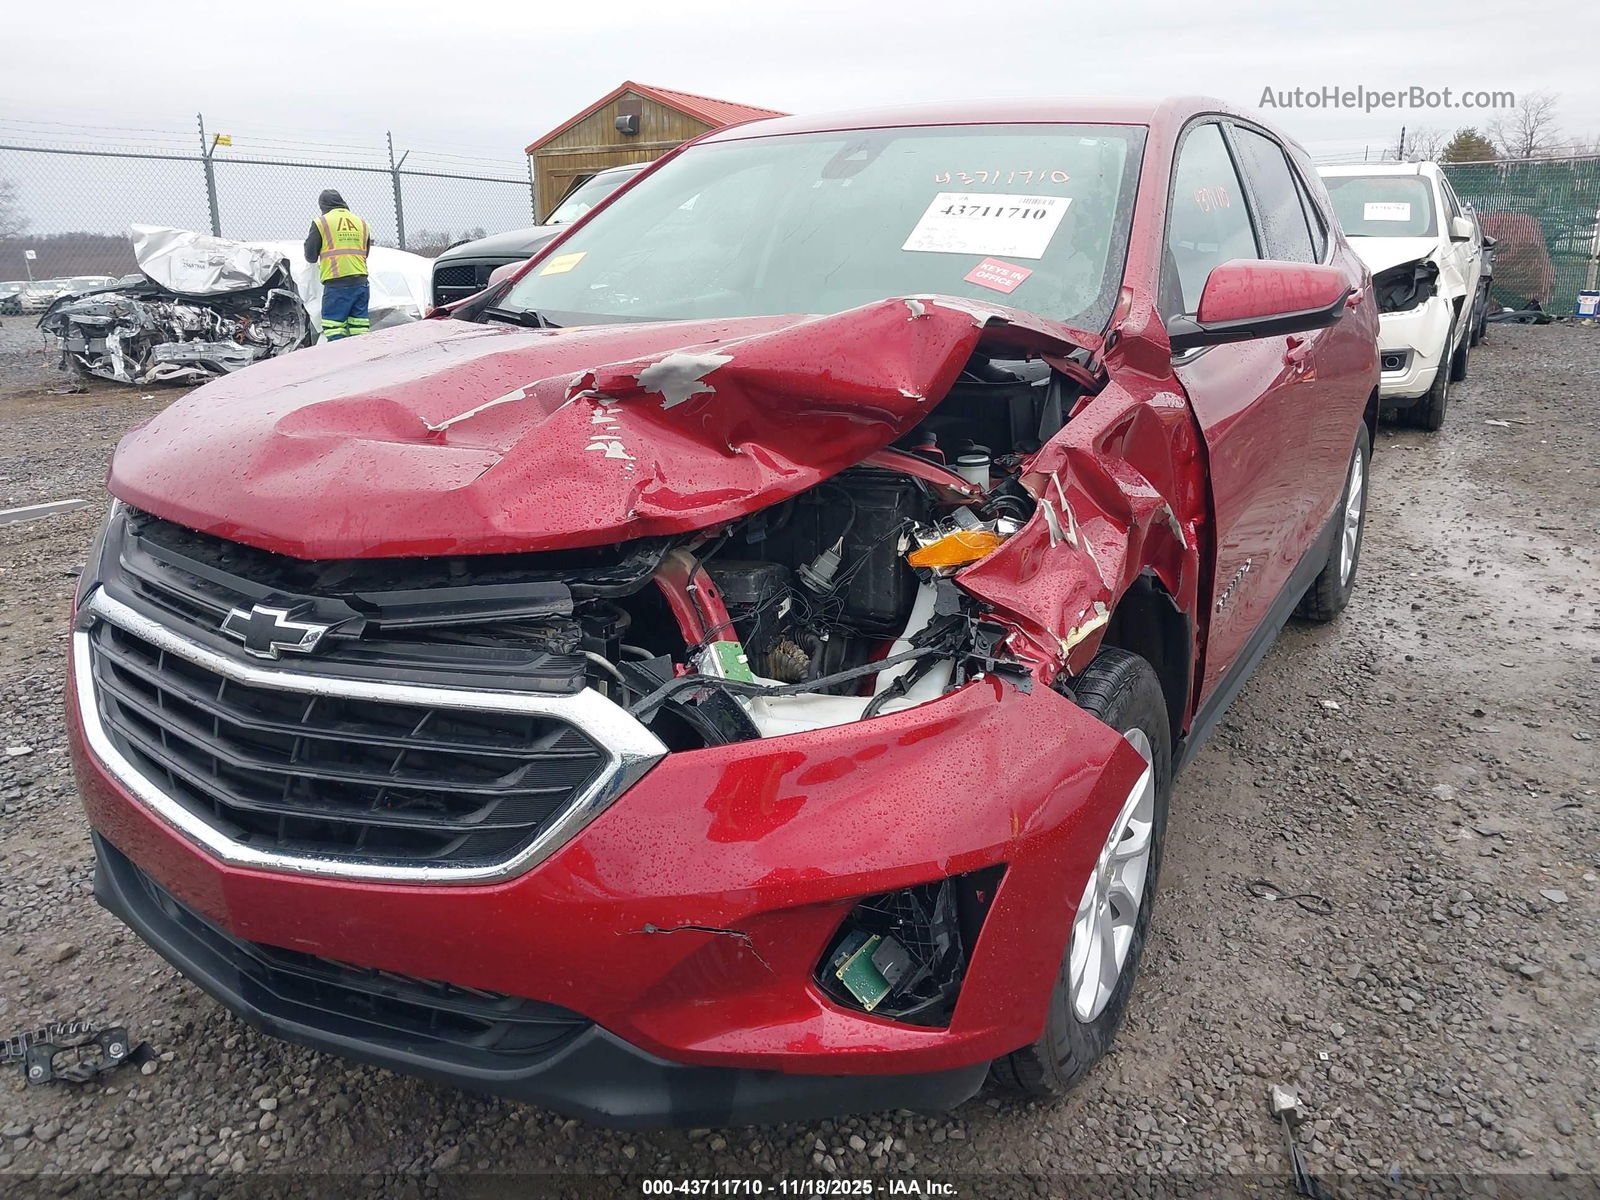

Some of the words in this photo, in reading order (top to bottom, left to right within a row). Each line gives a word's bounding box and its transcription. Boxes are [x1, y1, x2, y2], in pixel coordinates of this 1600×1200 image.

[940, 204, 1047, 220] 43711710
[975, 271, 1014, 287] OFFICE
[981, 263, 1009, 276] KEYS
[1010, 271, 1025, 281] IN
